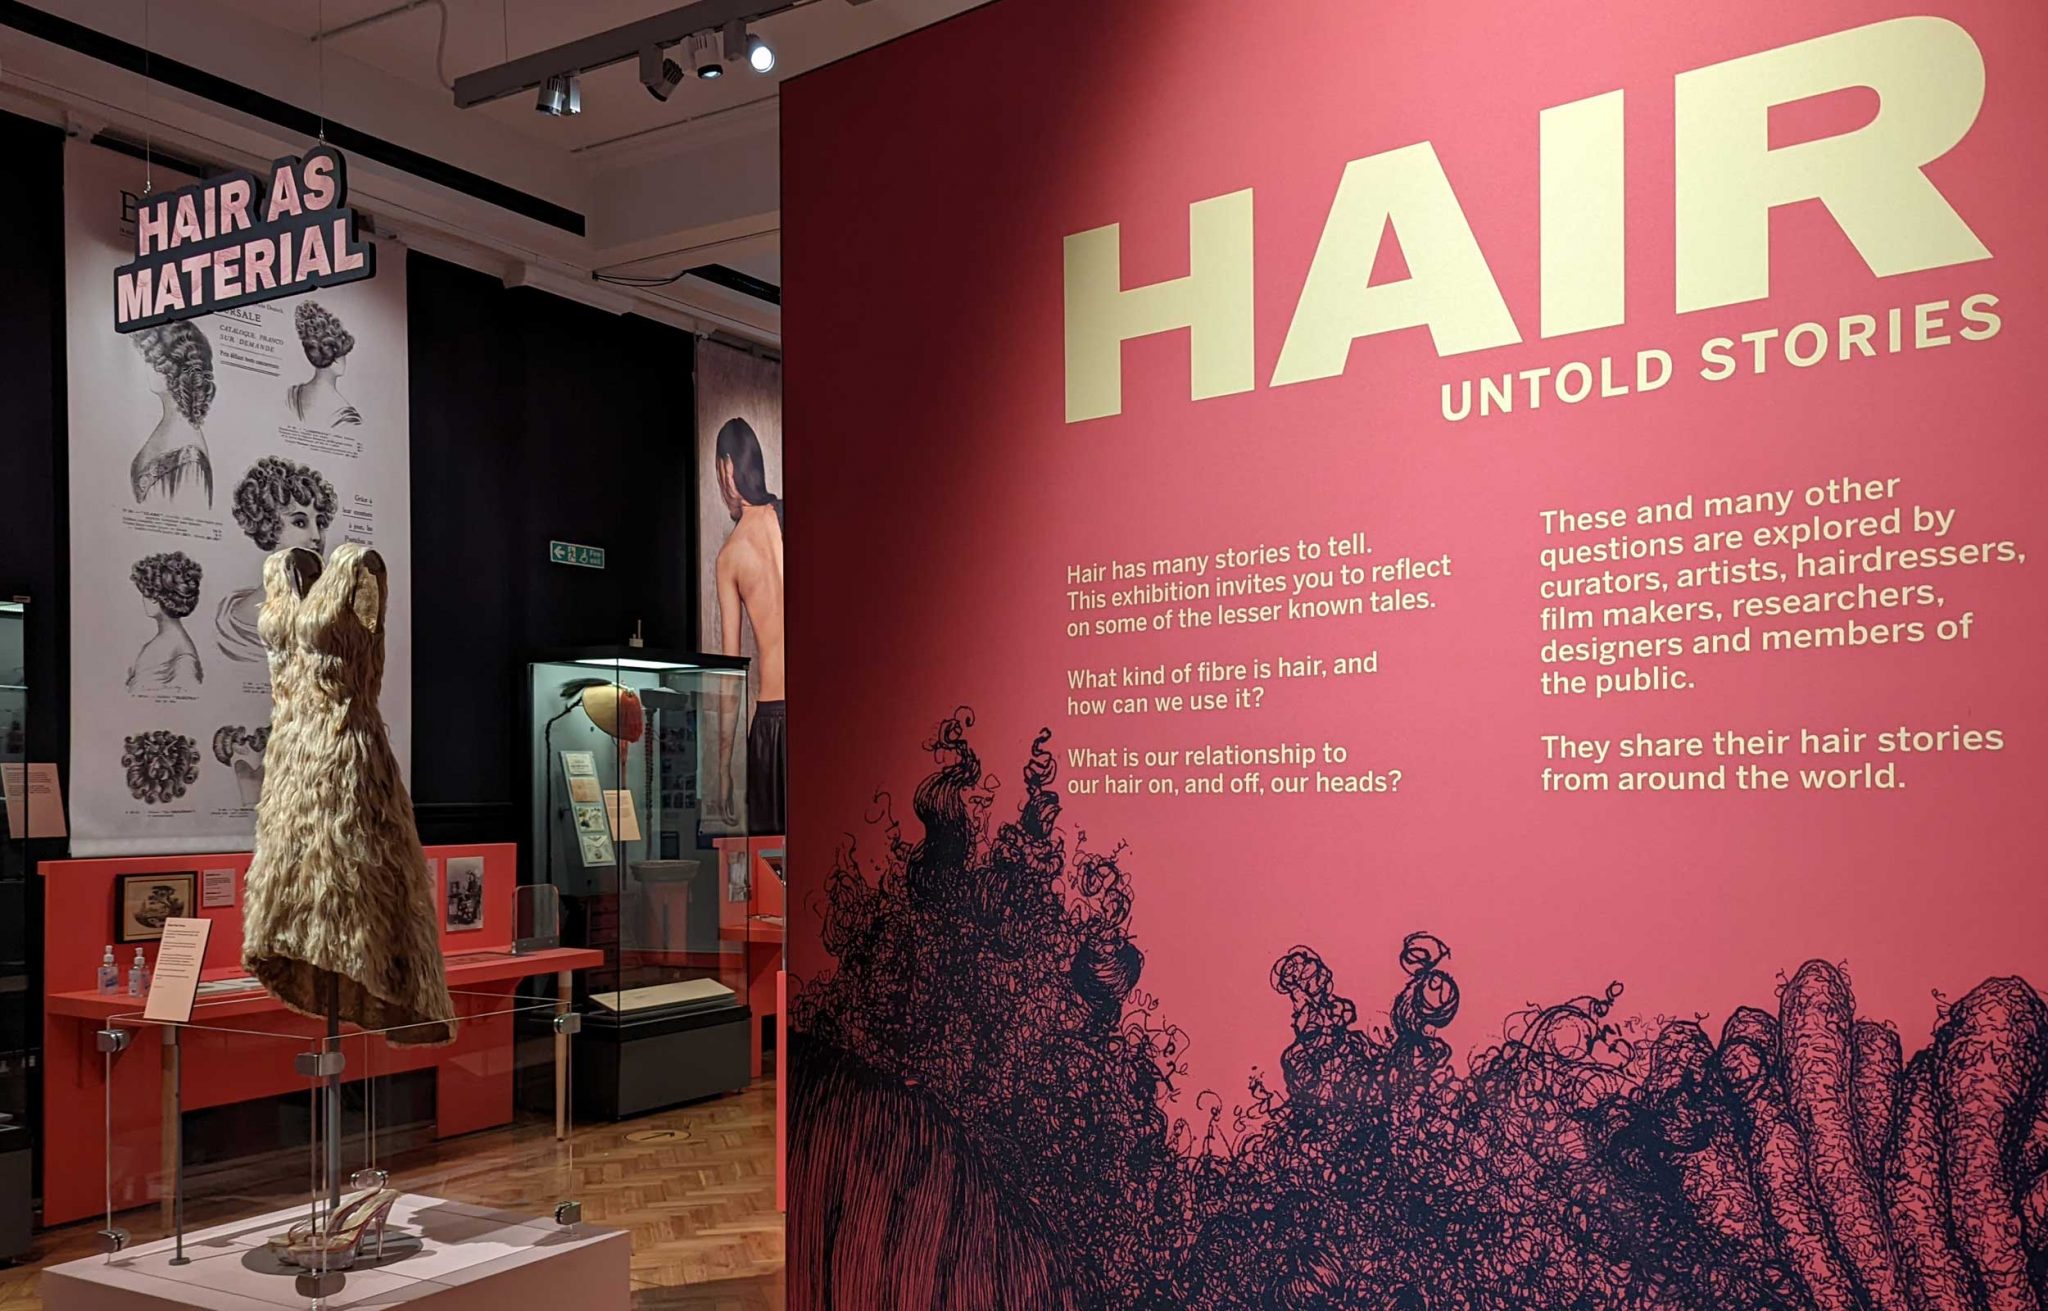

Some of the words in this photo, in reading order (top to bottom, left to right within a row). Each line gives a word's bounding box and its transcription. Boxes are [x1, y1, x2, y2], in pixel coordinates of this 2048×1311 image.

[138, 178, 251, 257] HAIR
[267, 155, 335, 223] AS
[1064, 16, 1992, 424] HAIR
[116, 218, 364, 324] MATERIAL
[1441, 349, 1672, 421] UNTOLD
[1700, 294, 2001, 381] STORIES
[1540, 509, 1626, 534] These
[1637, 496, 1693, 524] and
[1705, 490, 1793, 517] many
[1805, 477, 1900, 506] other
[1068, 566, 1106, 583] Hair
[1113, 561, 1146, 579] has
[1153, 556, 1208, 576] many
[1216, 544, 1290, 569] stories
[1297, 540, 1321, 560] to
[1328, 532, 1372, 557] tell.
[1540, 536, 1684, 571] questions
[1694, 531, 1743, 552] are
[1754, 508, 1900, 549] explored
[1914, 506, 1955, 536] by
[1068, 592, 1105, 609] This
[1112, 582, 1210, 606] exhibition
[1216, 574, 1287, 596] invites
[1293, 571, 1333, 595] you
[1341, 565, 1364, 585] to
[1372, 555, 1451, 582] reflect
[1541, 570, 1668, 599] curators,
[1677, 558, 1786, 588] artists,
[1798, 542, 2025, 577] hairdressers,
[1068, 622, 1089, 636] on
[1096, 617, 1147, 634] some
[1153, 609, 1172, 629] of
[1178, 608, 1211, 628] the
[1219, 605, 1282, 624] lesser
[1289, 598, 1363, 618] known
[1370, 589, 1436, 612] tales.
[1540, 607, 1593, 631] film
[1603, 600, 1722, 626] makers,
[1733, 584, 1943, 617] researchers,
[1541, 637, 1683, 666] designers
[1693, 627, 1750, 654] and
[1763, 620, 1924, 650] members
[1937, 612, 1973, 640] of
[1069, 669, 1116, 688] What
[1124, 665, 1164, 685] kind
[1172, 663, 1191, 683] of
[1198, 662, 1246, 681] fibre
[1254, 659, 1271, 678] is
[1279, 656, 1326, 677] hair,
[1334, 651, 1377, 675] and
[1541, 672, 1586, 695] the
[1596, 666, 1694, 698] public.
[1069, 698, 1105, 714] how
[1113, 698, 1147, 713] can
[1156, 697, 1183, 711] we
[1191, 694, 1227, 710] use
[1236, 687, 1264, 708] it?
[1069, 749, 1117, 767] What
[1124, 753, 1138, 766] is
[1146, 752, 1178, 766] our
[1185, 743, 1315, 768] relationship
[1323, 743, 1347, 763] to
[1541, 736, 1610, 764] They
[1620, 734, 1703, 757] share
[1713, 730, 1789, 755] their
[1801, 728, 1866, 753] hair
[1879, 725, 2003, 752] stories
[1069, 780, 1099, 793] our
[1106, 775, 1142, 793] hair
[1149, 779, 1178, 795] on,
[1185, 774, 1223, 793] and
[1230, 772, 1264, 795] off,
[1271, 777, 1308, 792] our
[1317, 769, 1402, 792] heads?
[1542, 768, 1608, 791] from
[1618, 765, 1725, 790] around
[1736, 765, 1789, 789] the
[1801, 763, 1904, 788] world.
